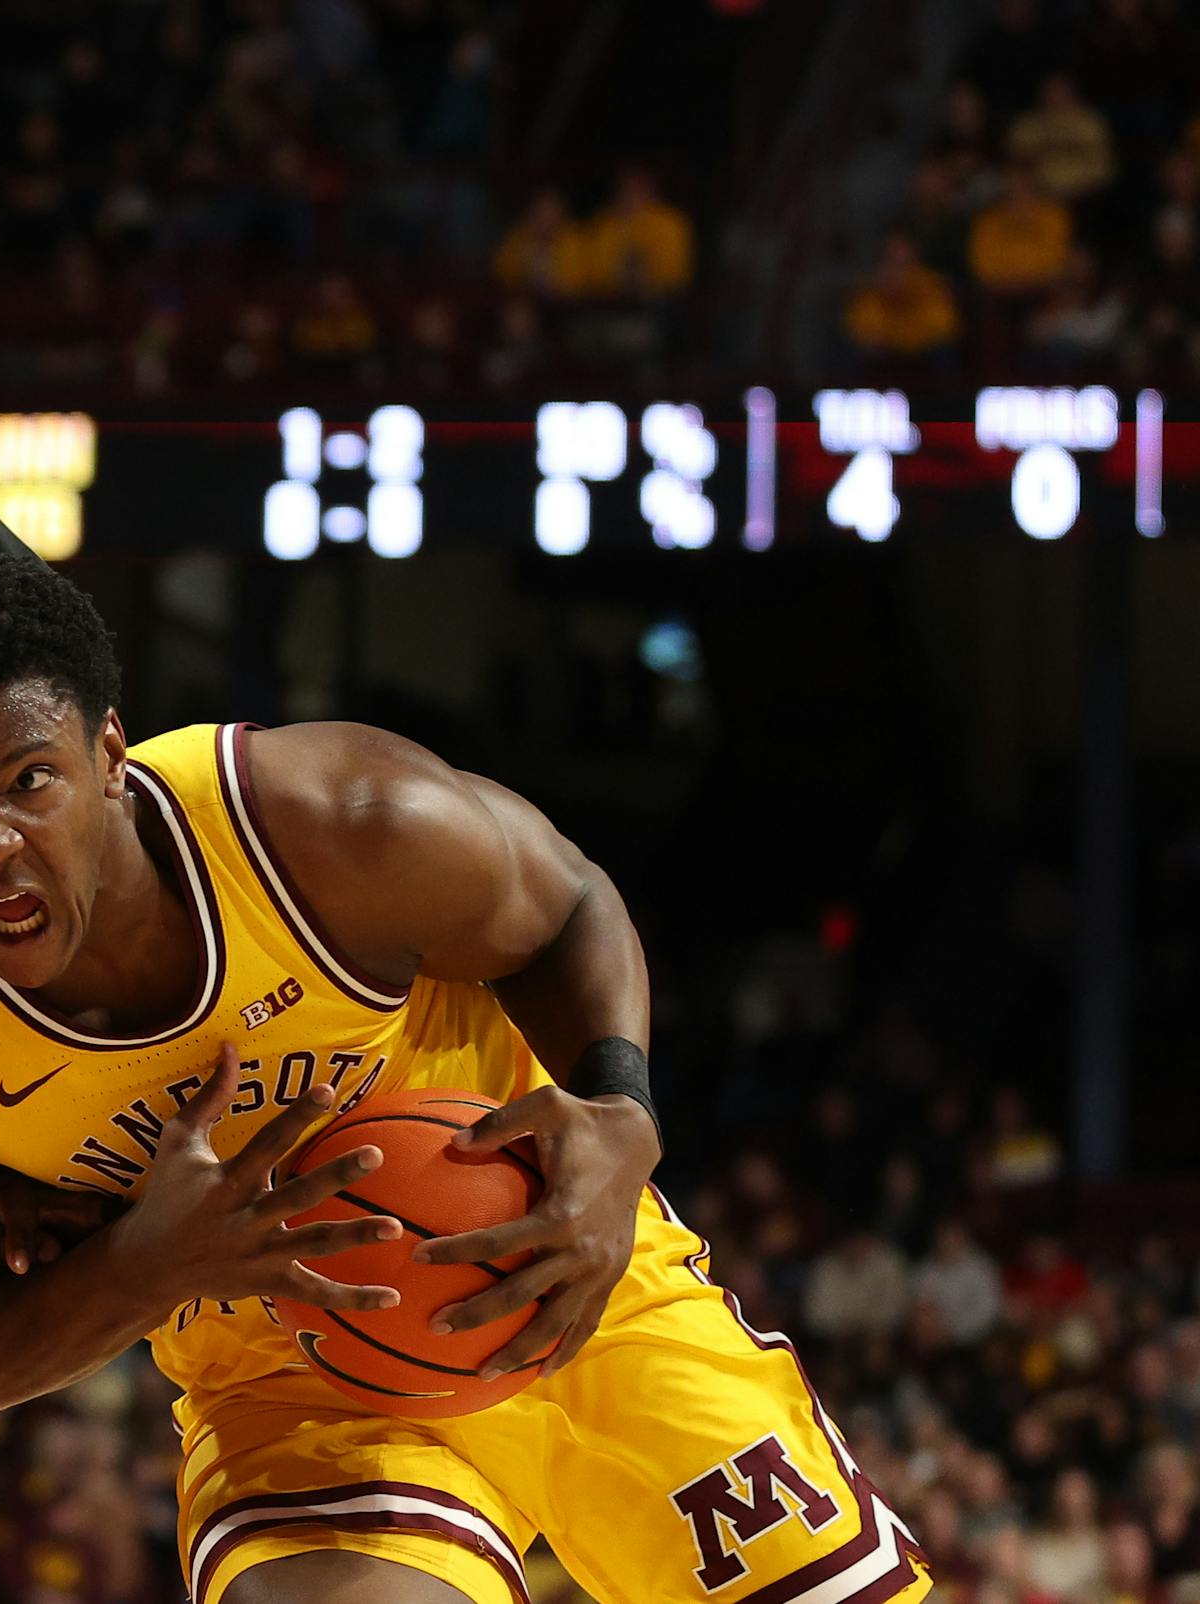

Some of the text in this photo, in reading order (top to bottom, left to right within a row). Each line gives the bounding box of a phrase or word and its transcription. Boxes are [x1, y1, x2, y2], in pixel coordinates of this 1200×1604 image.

[827, 447, 901, 542] 4
[1011, 445, 1081, 540] 0
[667, 1431, 843, 1595] M
